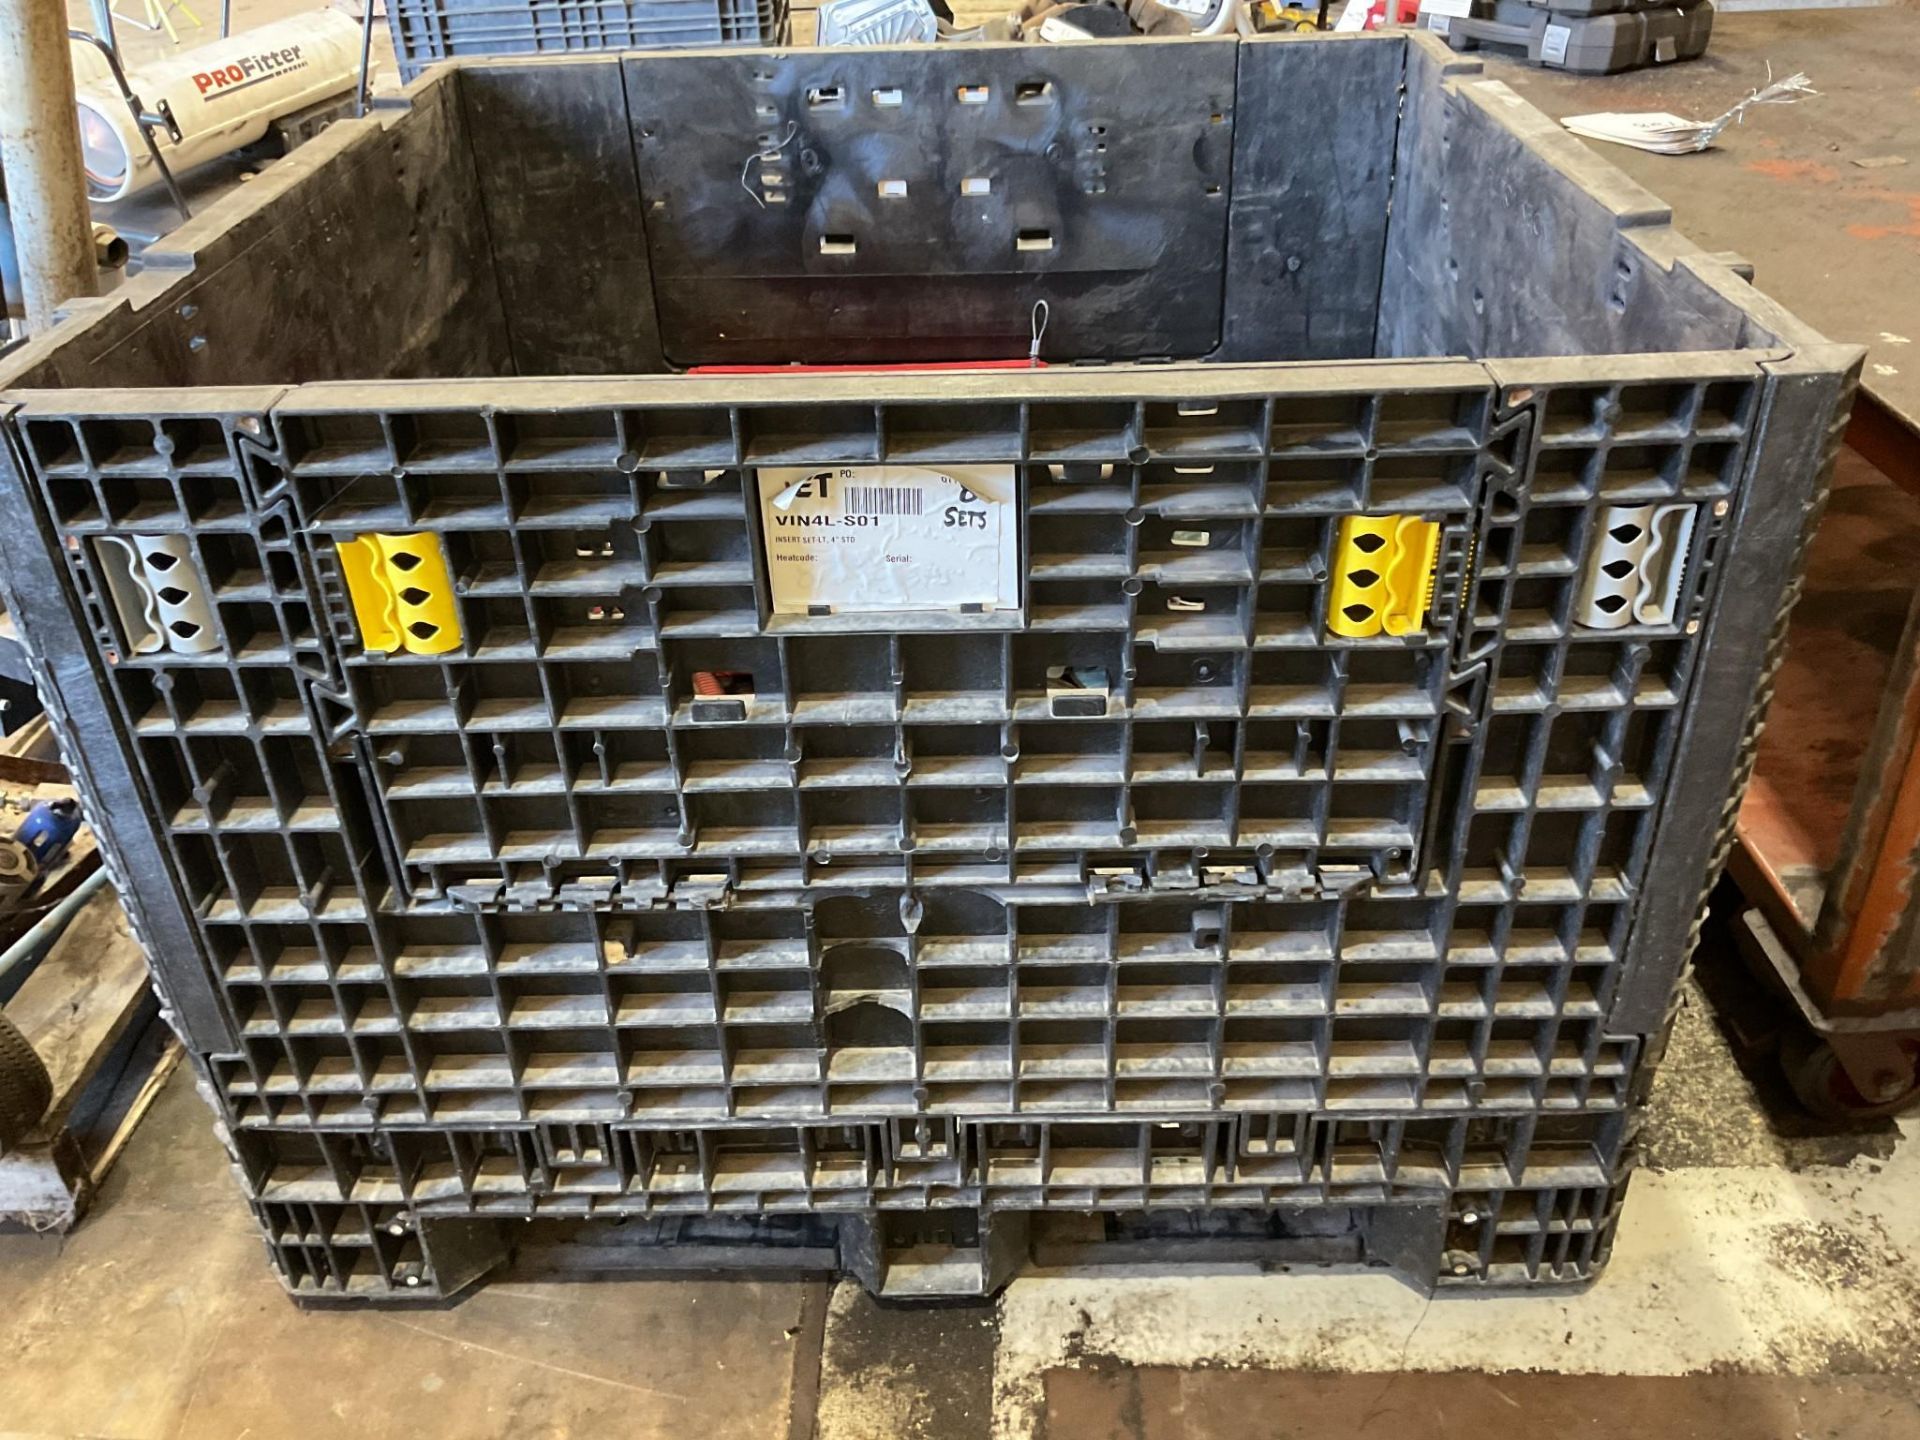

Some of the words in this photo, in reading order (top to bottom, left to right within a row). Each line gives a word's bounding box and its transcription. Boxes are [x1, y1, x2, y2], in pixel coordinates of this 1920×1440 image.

[192, 45, 301, 94] PROFitter
[840, 469, 855, 478] PO:
[776, 515, 880, 527] VIN4L-S01
[776, 554, 818, 562] Heatcode:
[886, 554, 912, 563] Serial:
